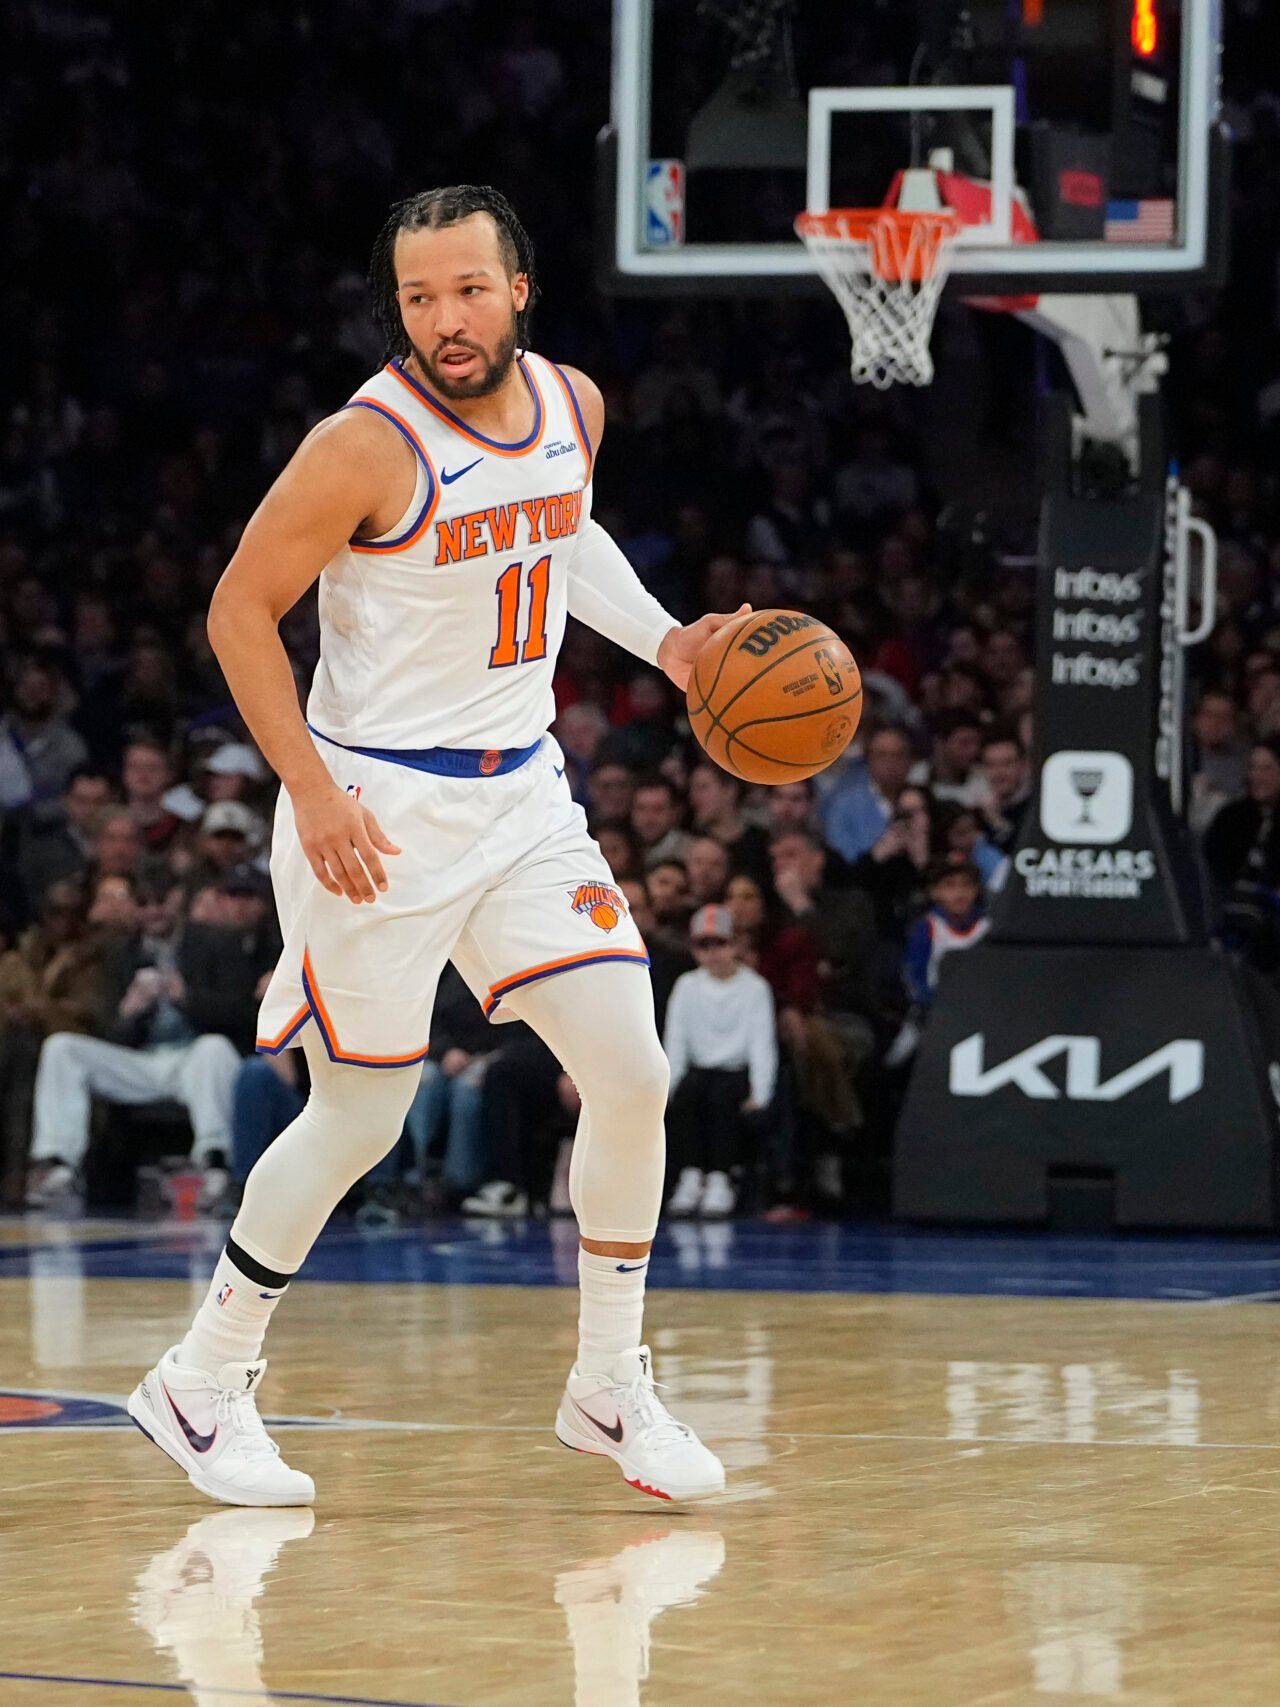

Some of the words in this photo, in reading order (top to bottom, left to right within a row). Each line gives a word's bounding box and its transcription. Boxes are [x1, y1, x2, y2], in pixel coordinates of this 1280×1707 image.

[434, 502, 519, 566] NEW
[488, 554, 552, 669] 11
[1015, 848, 1156, 880] CAESARS
[949, 1032, 1204, 1104] KIA
